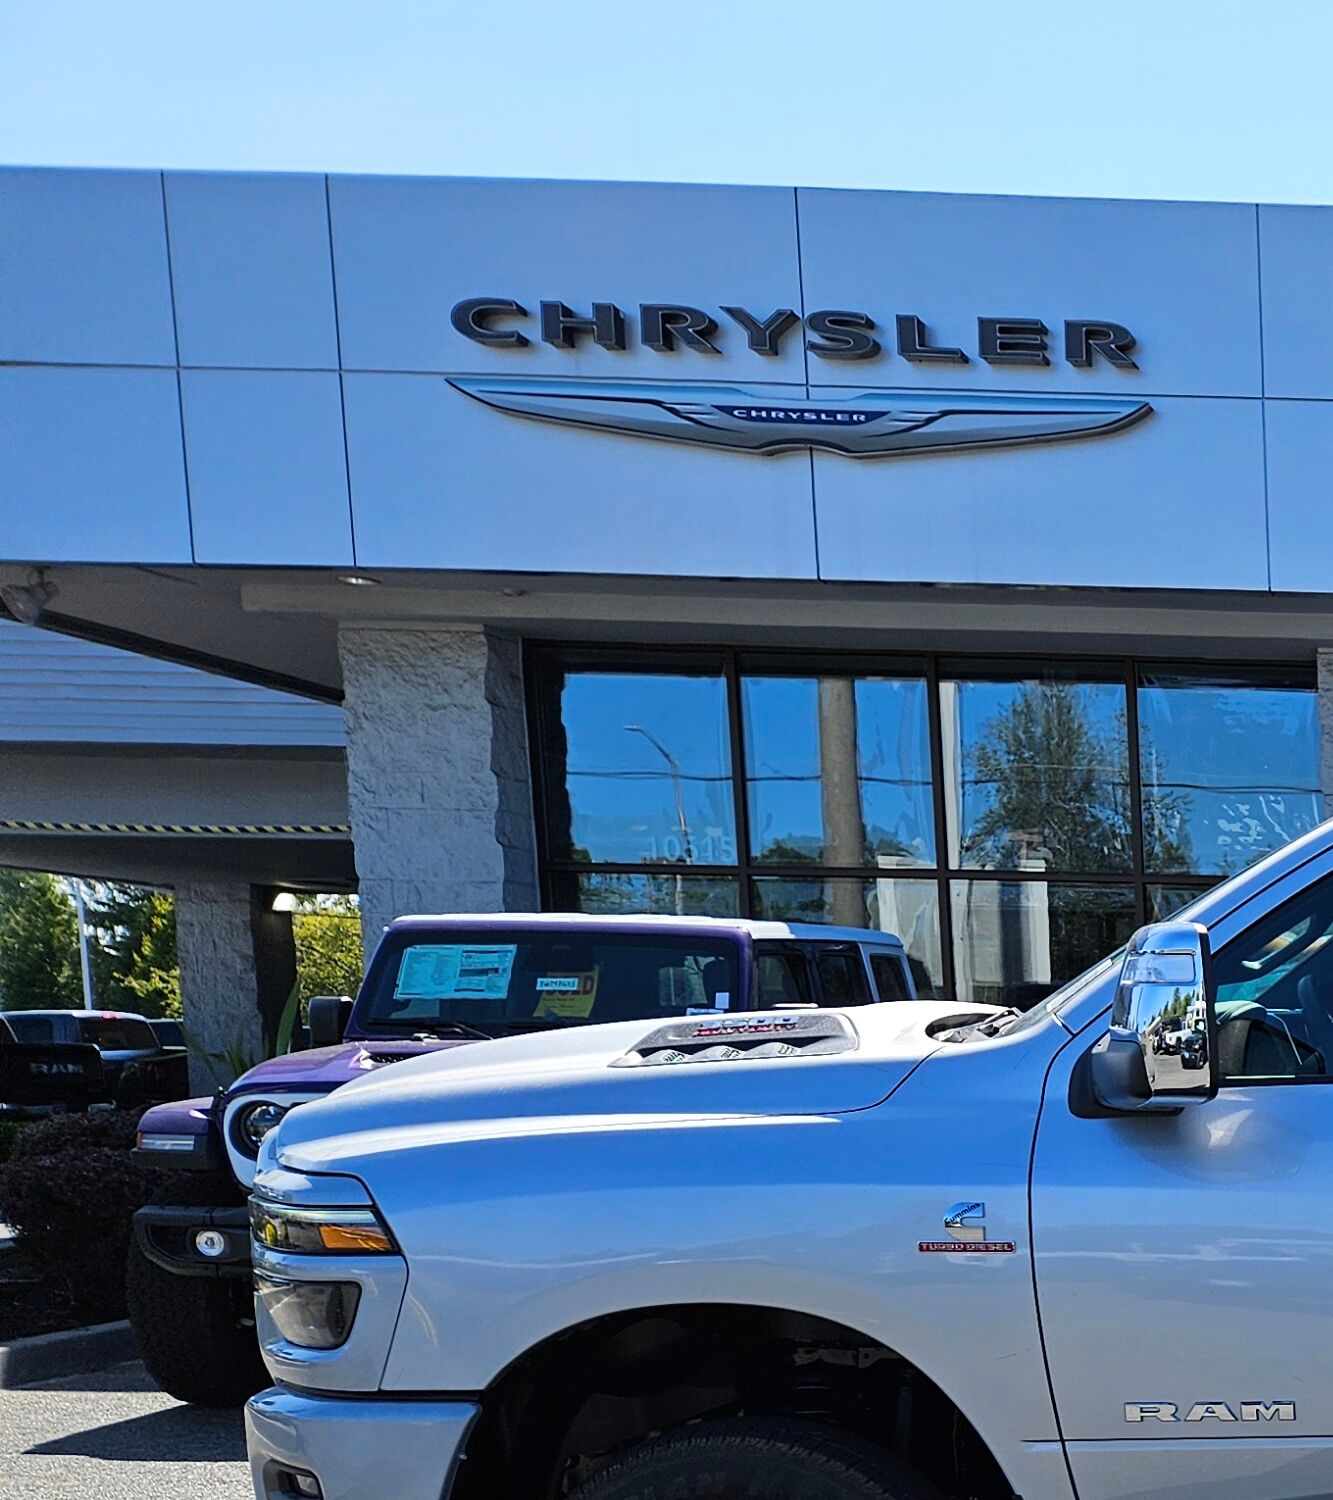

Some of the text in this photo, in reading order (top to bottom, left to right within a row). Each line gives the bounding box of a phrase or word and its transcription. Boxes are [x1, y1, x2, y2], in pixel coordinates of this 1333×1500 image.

[450, 297, 1140, 370] CHRYSLER
[733, 409, 866, 421] CHRYSLER
[30, 1062, 84, 1074] RAM
[943, 1202, 982, 1225] Cummins
[920, 1243, 1012, 1251] TURBO DIESEL
[1124, 1401, 1297, 1422] RAM
